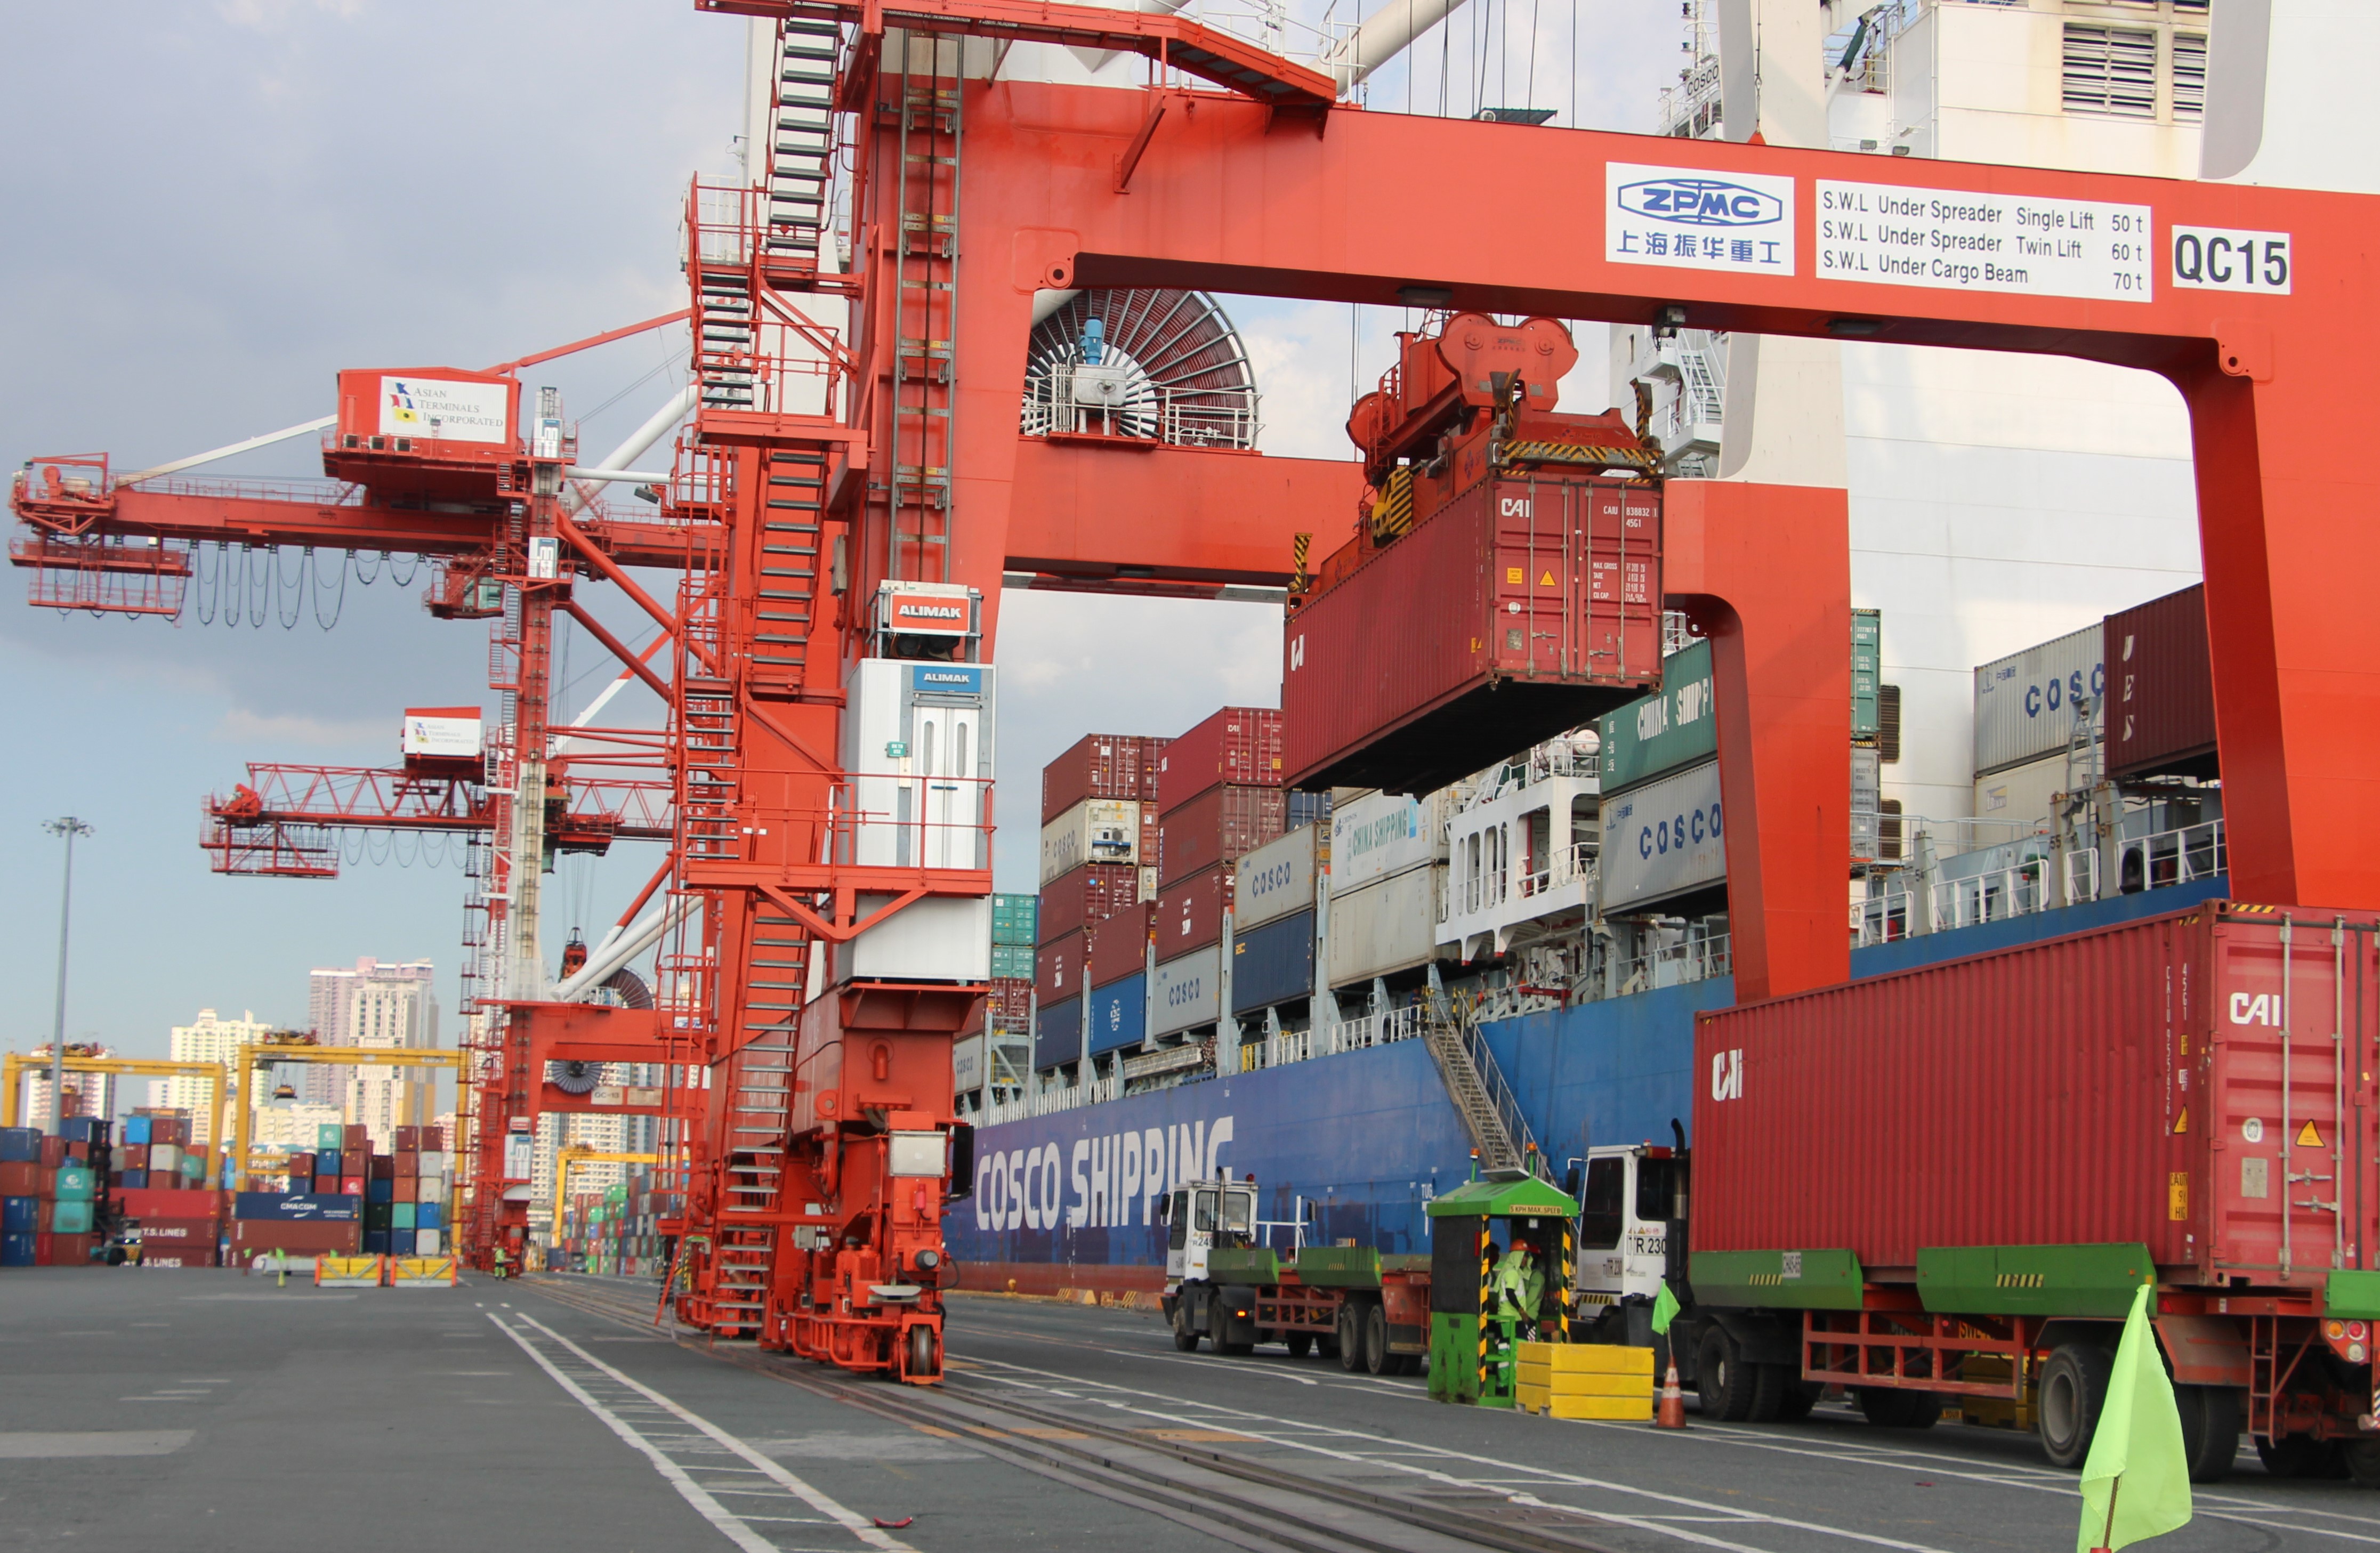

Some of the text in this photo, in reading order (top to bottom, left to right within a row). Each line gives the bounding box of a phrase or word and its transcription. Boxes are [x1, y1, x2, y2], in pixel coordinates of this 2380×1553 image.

[1687, 64, 1719, 96] COSCO
[1643, 188, 1760, 219] ZPMC
[1823, 190, 2143, 233] S.W.L Under Spreader Single Lift 50 t
[1616, 230, 1781, 264] 上海振华重工
[1823, 220, 2143, 262] S.W.L Under Spreader Twin Lift 60 t
[1823, 250, 2143, 290] S.W.L Under Cargo Beam 70 t
[2175, 233, 2287, 286] QC15
[413, 387, 447, 399] ASIAN
[418, 400, 480, 414] TERMINALS
[423, 411, 504, 427] INCORPORATED
[1501, 498, 1530, 518] CAI
[1603, 506, 1618, 515] CAIU
[1626, 507, 1650, 516] 838832
[1626, 519, 1641, 528] 45G1
[898, 604, 962, 619] ALIMAK
[923, 672, 970, 683] ALIMAK
[1053, 830, 1076, 858] COSCO
[1353, 808, 1407, 856] CHINA SHIPPING
[1640, 803, 1722, 860] COSCO
[2050, 834, 2061, 850] 55
[1253, 861, 1290, 897] COSCO
[1169, 977, 1199, 1007] COSCO
[2229, 991, 2280, 1026] CAI
[976, 1115, 1233, 1232] COSCO SHIPPING
[1421, 1183, 1433, 1199] TUG
[159, 1228, 187, 1236] LINES
[1648, 1238, 1666, 1254] 230
[154, 1258, 182, 1267] LINES
